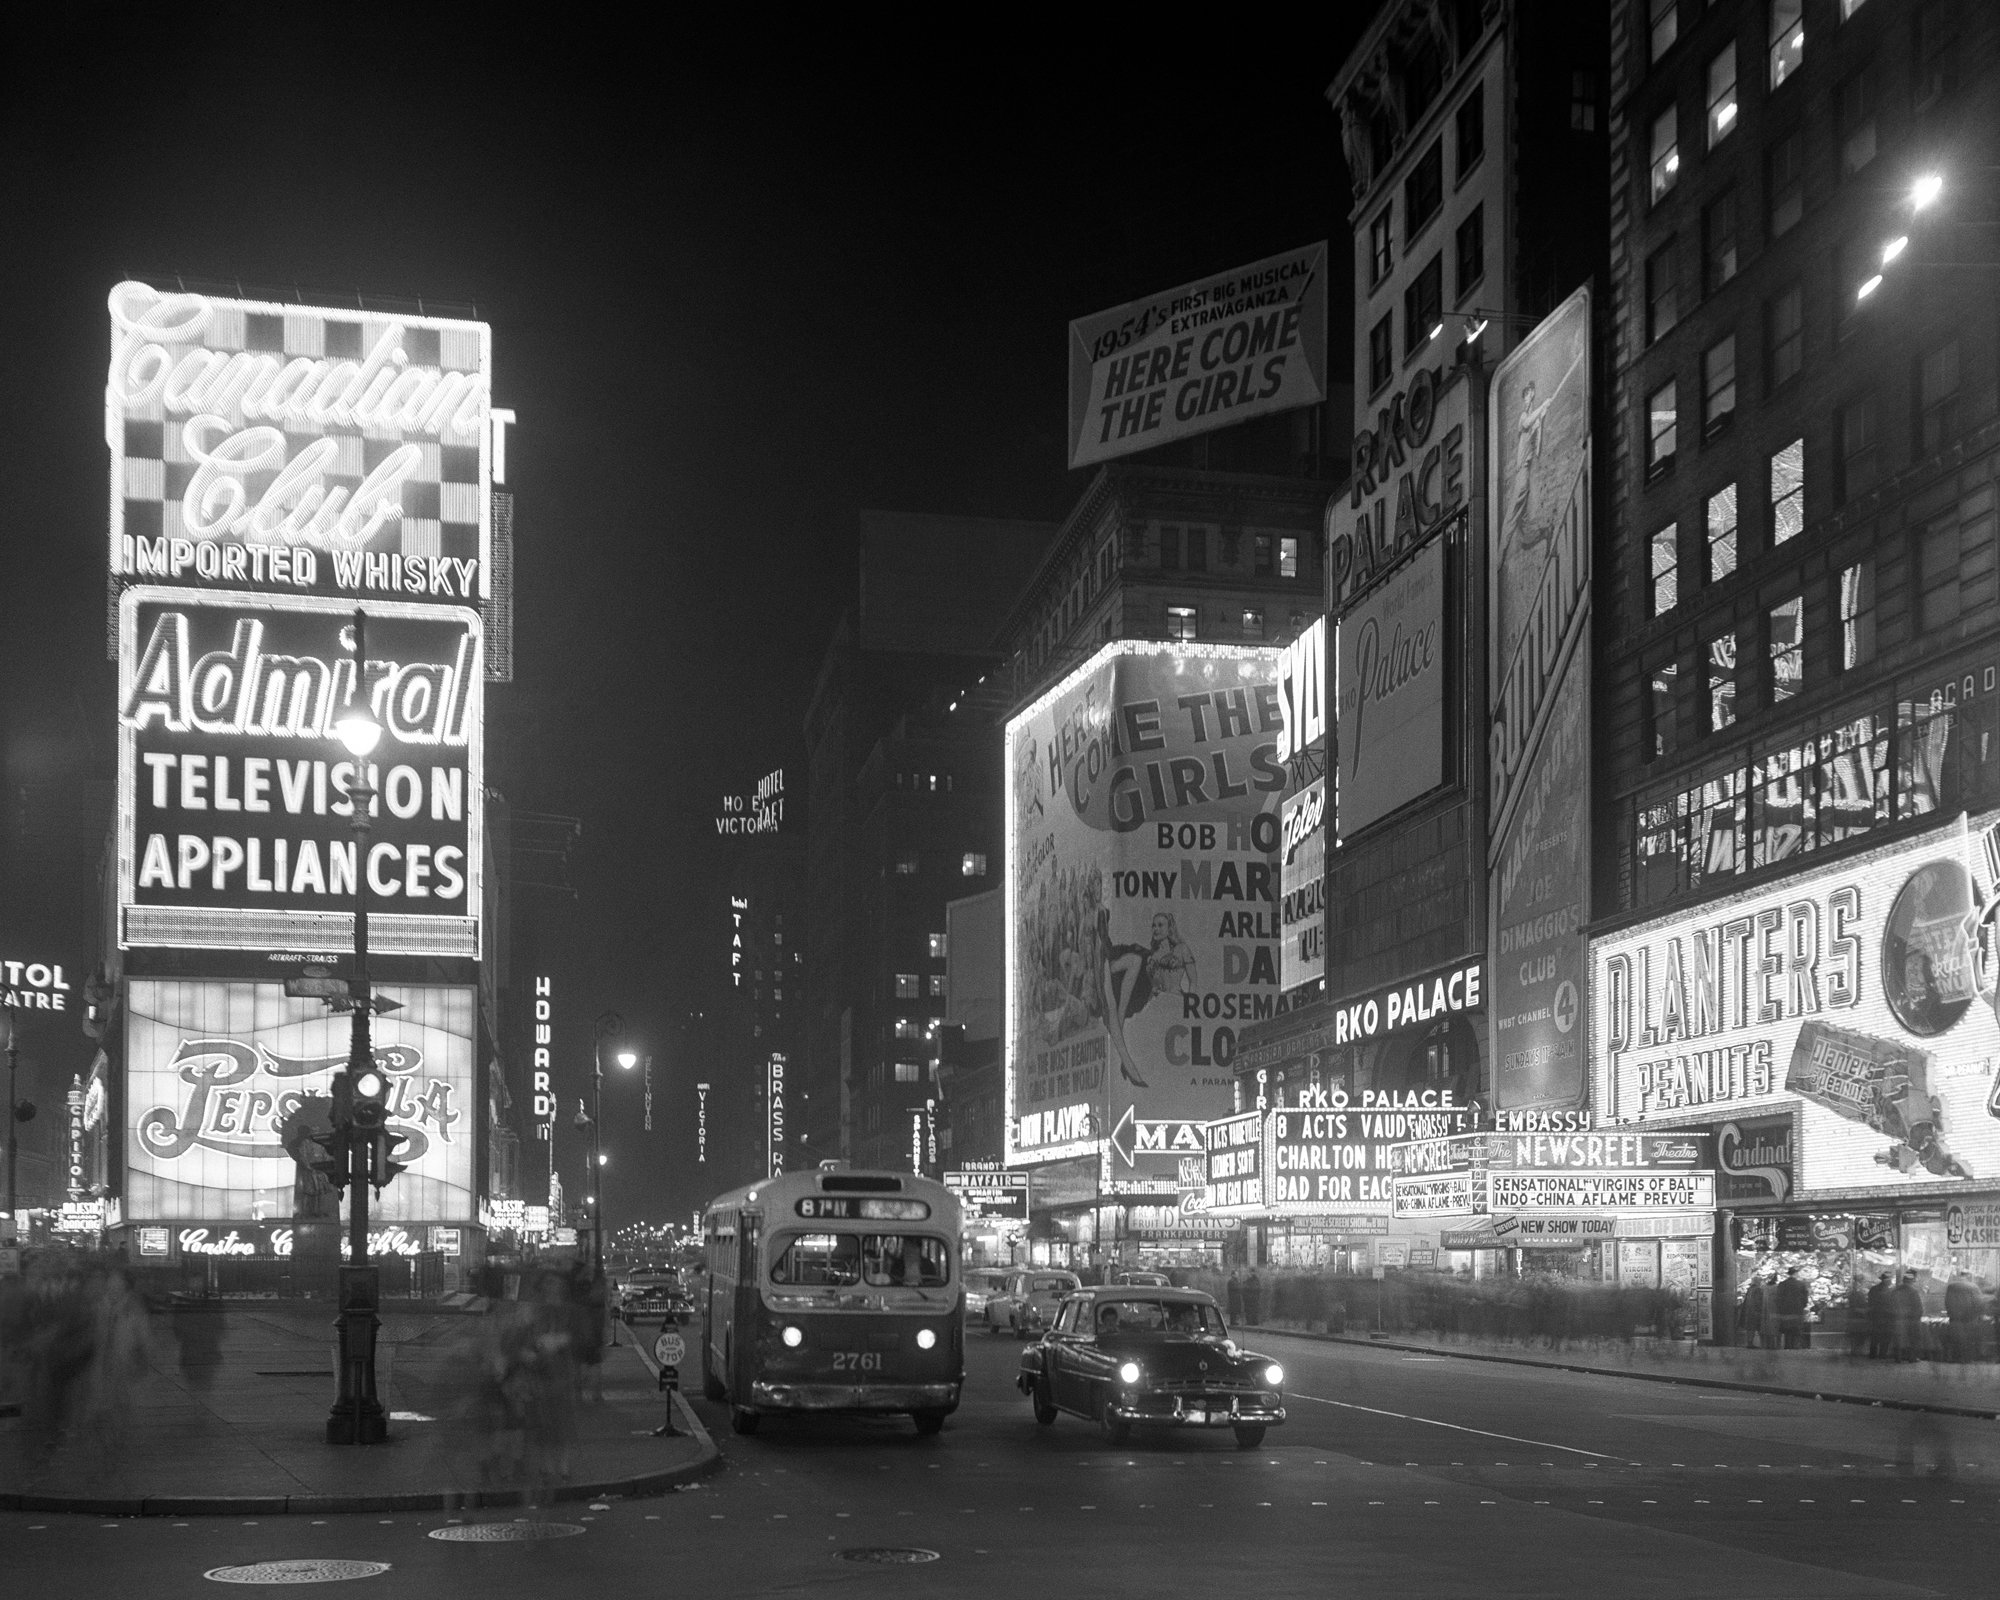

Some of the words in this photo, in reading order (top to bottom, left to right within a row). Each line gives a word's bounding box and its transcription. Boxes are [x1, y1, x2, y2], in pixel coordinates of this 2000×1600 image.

[1093, 306, 1170, 363] 1954's
[1170, 290, 1208, 316] FIRST
[1213, 281, 1236, 303] BIG
[1240, 259, 1310, 293] MUSICAL
[1171, 286, 1289, 335] EXTRAVAGANZA
[107, 280, 492, 438] Canadian
[1103, 336, 1195, 400] HERE
[1200, 306, 1301, 382] COME
[1100, 388, 1167, 444] THE
[1174, 354, 1287, 422] GIRLS
[1351, 368, 1436, 510] RKO
[182, 413, 414, 551] Club
[1331, 423, 1464, 606] PALACE
[122, 534, 317, 586] IMPORTED
[331, 548, 479, 598] WHISKY
[121, 612, 479, 746] Admiral
[1351, 616, 1437, 783] Palace
[1177, 682, 1283, 744] THE
[143, 752, 463, 822] TELEVISION
[757, 768, 784, 801] HOTEL
[1110, 743, 1288, 833] GIRLS
[715, 817, 778, 835] VICTORA
[759, 798, 784, 832] TAFT
[1157, 822, 1217, 850] BOB
[138, 833, 465, 900] APPLIANCES
[1113, 870, 1178, 900] TONY
[732, 913, 742, 987] TAFT
[0, 960, 71, 990] TOL
[0, 988, 65, 1010] ATRE
[1336, 1000, 1379, 1045] RKO
[1387, 965, 1480, 1030] PALACE
[1517, 1006, 1551, 1025] CHANNEL
[1557, 985, 1574, 1026] 4
[1606, 885, 1864, 1118] PLANTERS
[534, 976, 551, 1116] HOWARD
[1638, 1041, 1775, 1112] PEANUTS
[772, 1064, 784, 1142] BRASS
[1299, 1090, 1348, 1108] RKO
[1362, 1090, 1454, 1108] PALACE
[698, 1091, 706, 1163] VICTORIA
[1044, 1102, 1091, 1144] PLAYING
[1276, 1114, 1287, 1139] 8
[1302, 1114, 1348, 1139] ACTS
[1494, 1110, 1591, 1133] EMBASSY
[69, 1104, 83, 1188] CAPITOL
[1276, 1145, 1366, 1170] CHARLTON
[1403, 1140, 1454, 1174] NEWSREEL
[1489, 1139, 1512, 1159] The
[1515, 1135, 1650, 1167] NEWSREEL
[1652, 1141, 1699, 1159] Theatre
[1718, 1122, 1793, 1200] Cardinal
[961, 1174, 1012, 1187] MAYFAIR
[1276, 1175, 1310, 1201] BAD
[1318, 1175, 1352, 1200] FOR
[1581, 1191, 1637, 1207] AFLAME
[1644, 1191, 1695, 1206] PREVUE
[1648, 1176, 1667, 1192] OF
[179, 1228, 256, 1256] Castro
[1140, 1230, 1228, 1239] FRANKFURTERS
[1520, 1220, 1544, 1234] NEW
[1549, 1219, 1578, 1233] SHOW
[1581, 1218, 1616, 1233] TODAY
[659, 1349, 684, 1362] STOP
[661, 1336, 682, 1348] BUS
[832, 1353, 882, 1370] 2761
